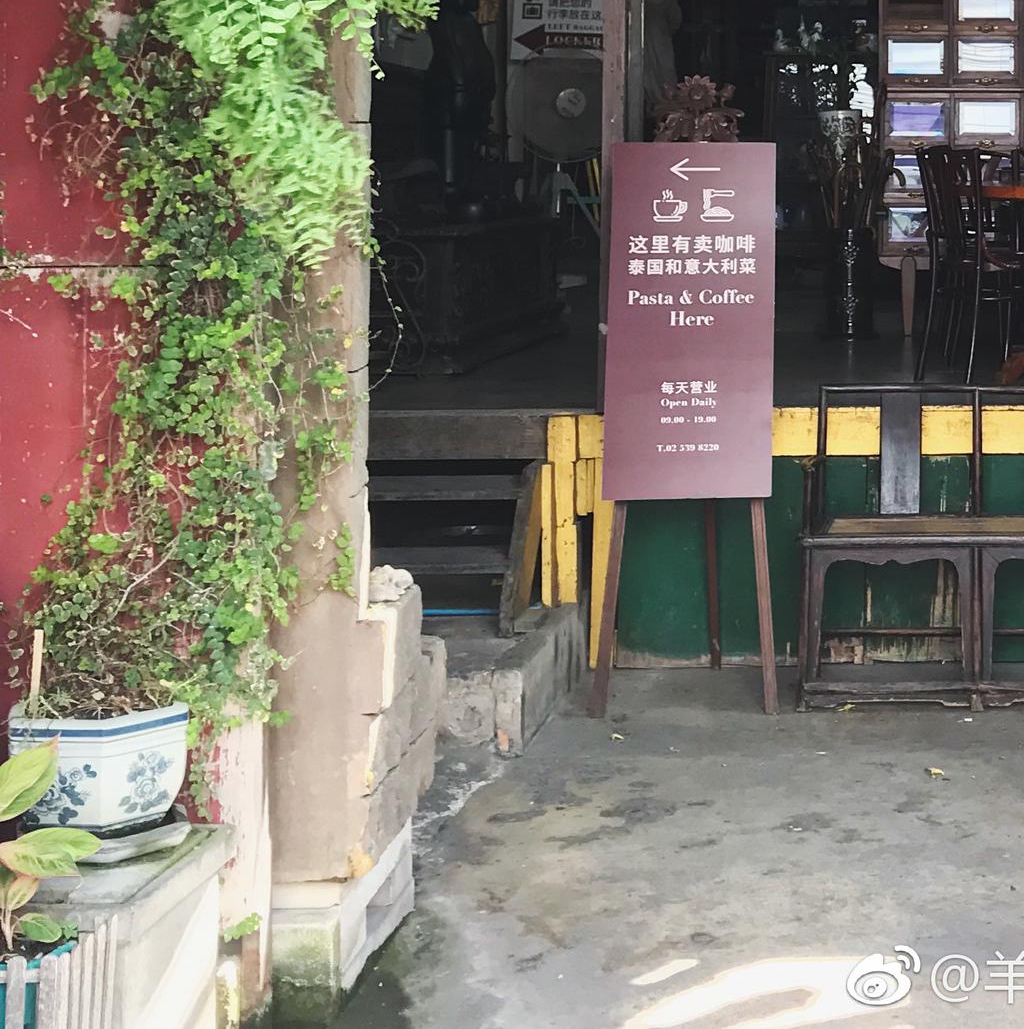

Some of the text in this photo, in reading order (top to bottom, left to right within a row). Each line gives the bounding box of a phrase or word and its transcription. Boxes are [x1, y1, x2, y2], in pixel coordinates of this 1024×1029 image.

[628, 234, 756, 254] 这里有卖咖啡
[628, 257, 756, 275] 泰国和意大利菜
[627, 288, 755, 305] Pasta & Coffee
[669, 310, 715, 327] Here
[660, 380, 718, 395] 每天营业
[660, 397, 717, 409] Open Daily
[660, 416, 685, 424] 09.00
[694, 415, 717, 423] 19.00
[656, 443, 720, 452] T.02 539 8220
